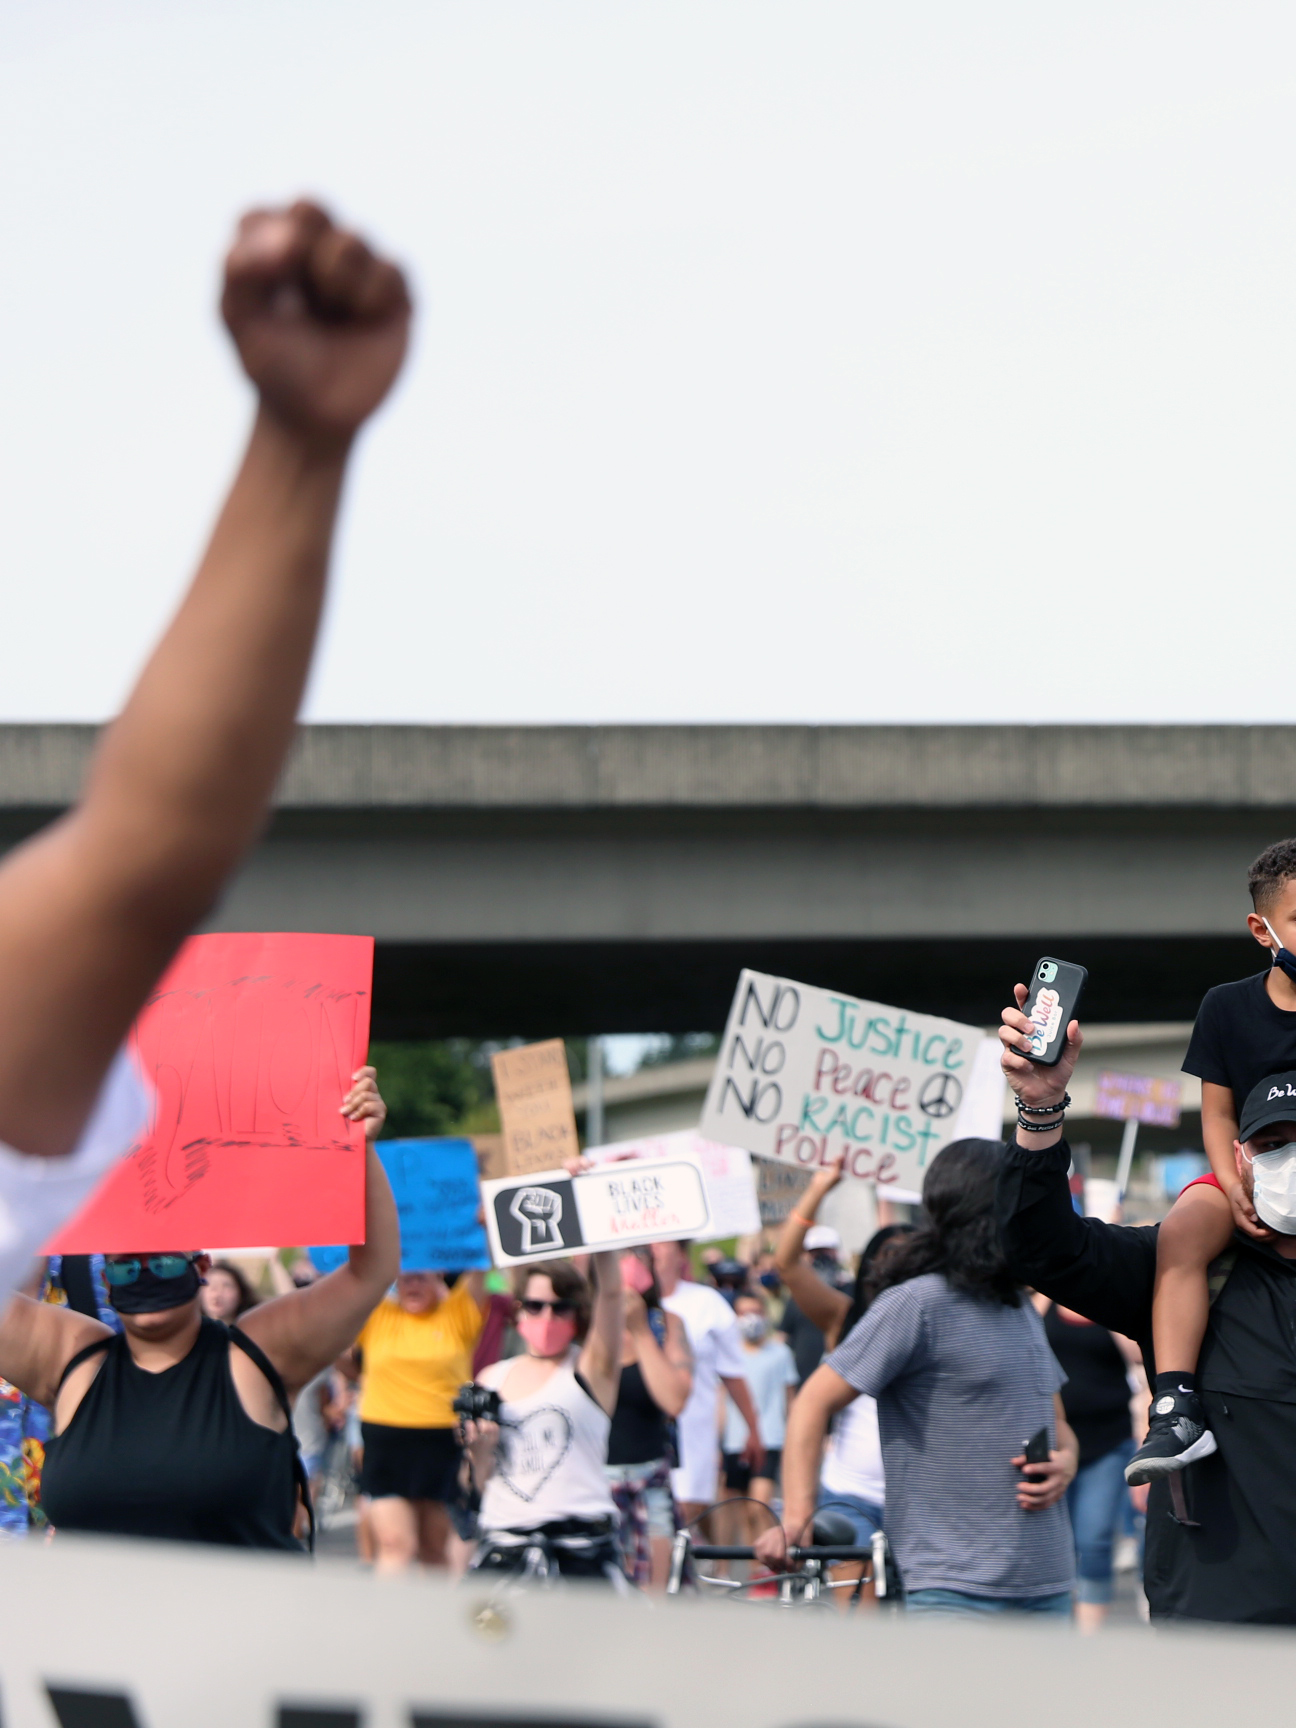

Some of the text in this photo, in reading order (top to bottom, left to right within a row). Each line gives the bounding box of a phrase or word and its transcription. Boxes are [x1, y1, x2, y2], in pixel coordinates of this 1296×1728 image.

[740, 980, 800, 1032] NO
[1032, 993, 1055, 1028] Well
[728, 1034, 787, 1076] NO
[718, 1076, 783, 1123] NO
[1267, 1086, 1284, 1101] Be
[608, 1176, 666, 1198] BLACK
[614, 1194, 666, 1215] LIVES
